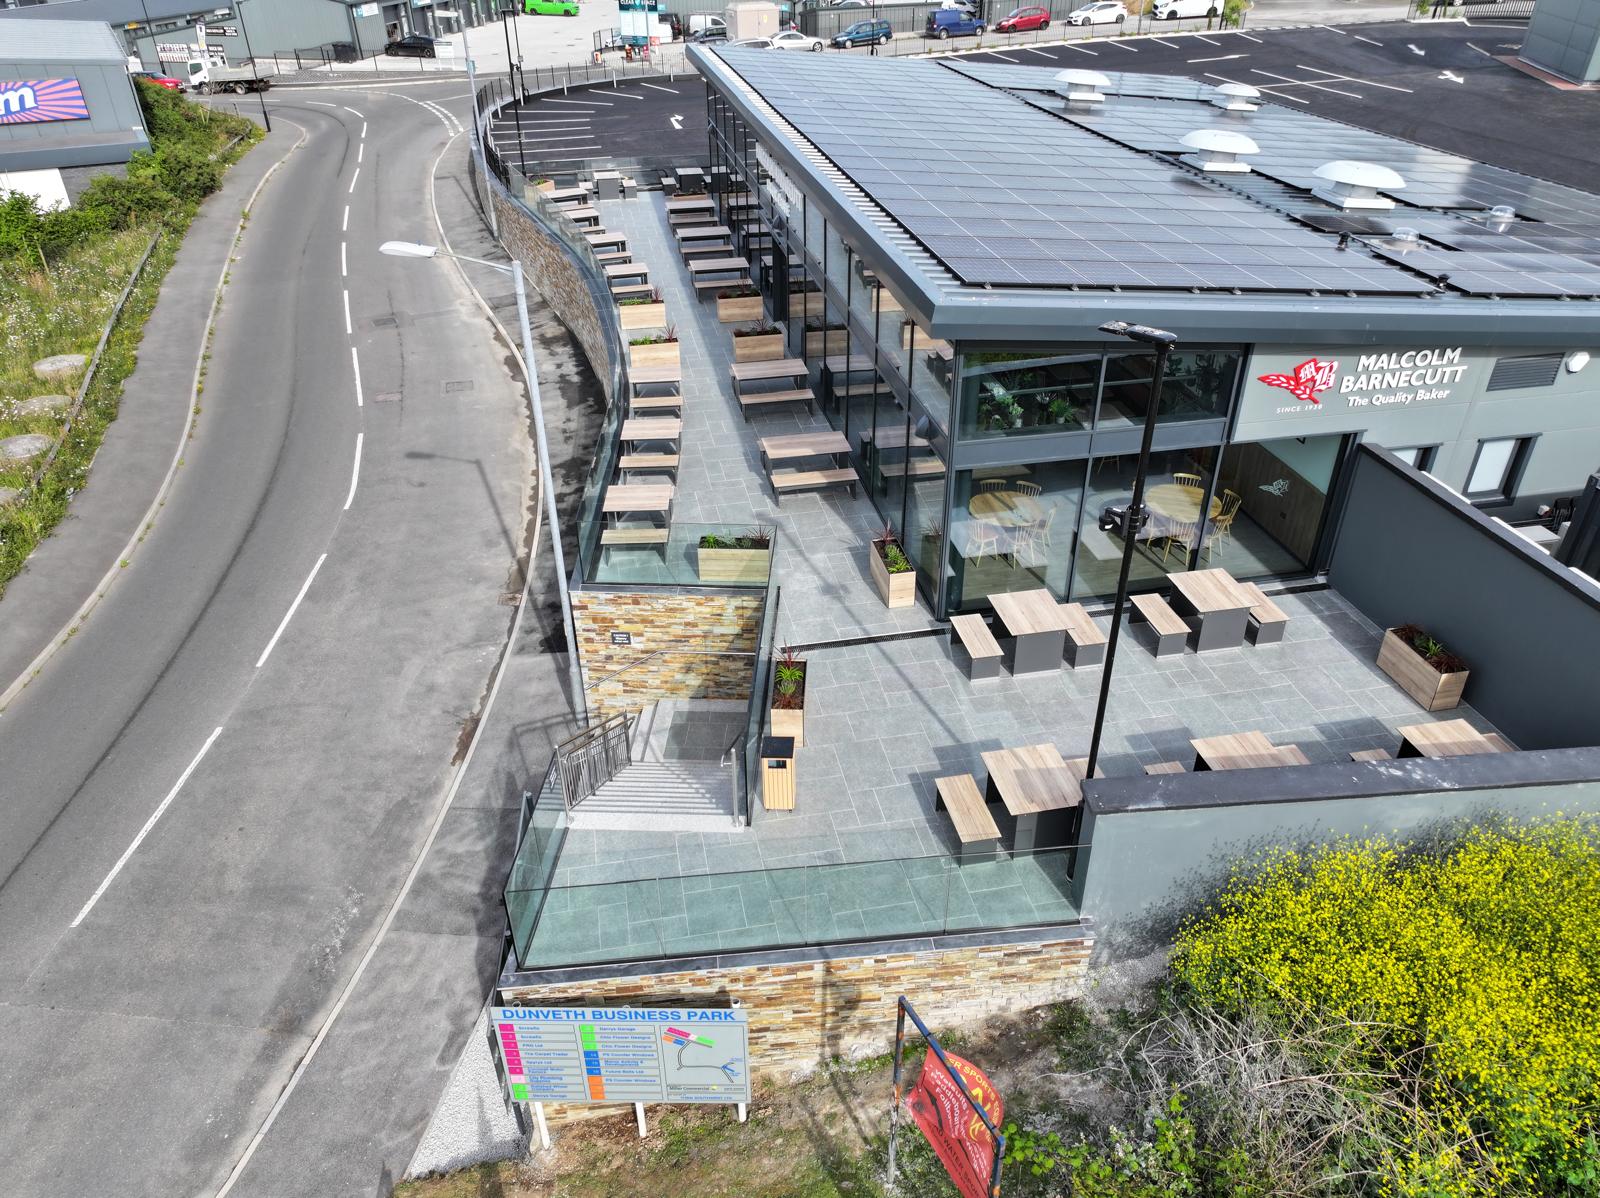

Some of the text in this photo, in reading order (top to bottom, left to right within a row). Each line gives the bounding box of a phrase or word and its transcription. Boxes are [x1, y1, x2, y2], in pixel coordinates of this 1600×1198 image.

[1357, 347, 1462, 372] MALCOLM
[1339, 365, 1468, 394] BARNECUTT
[1347, 388, 1451, 407] The Quality Baker
[1276, 405, 1301, 414] SINCE
[502, 1009, 736, 1021] DUNVETH BUSINESS PARK
